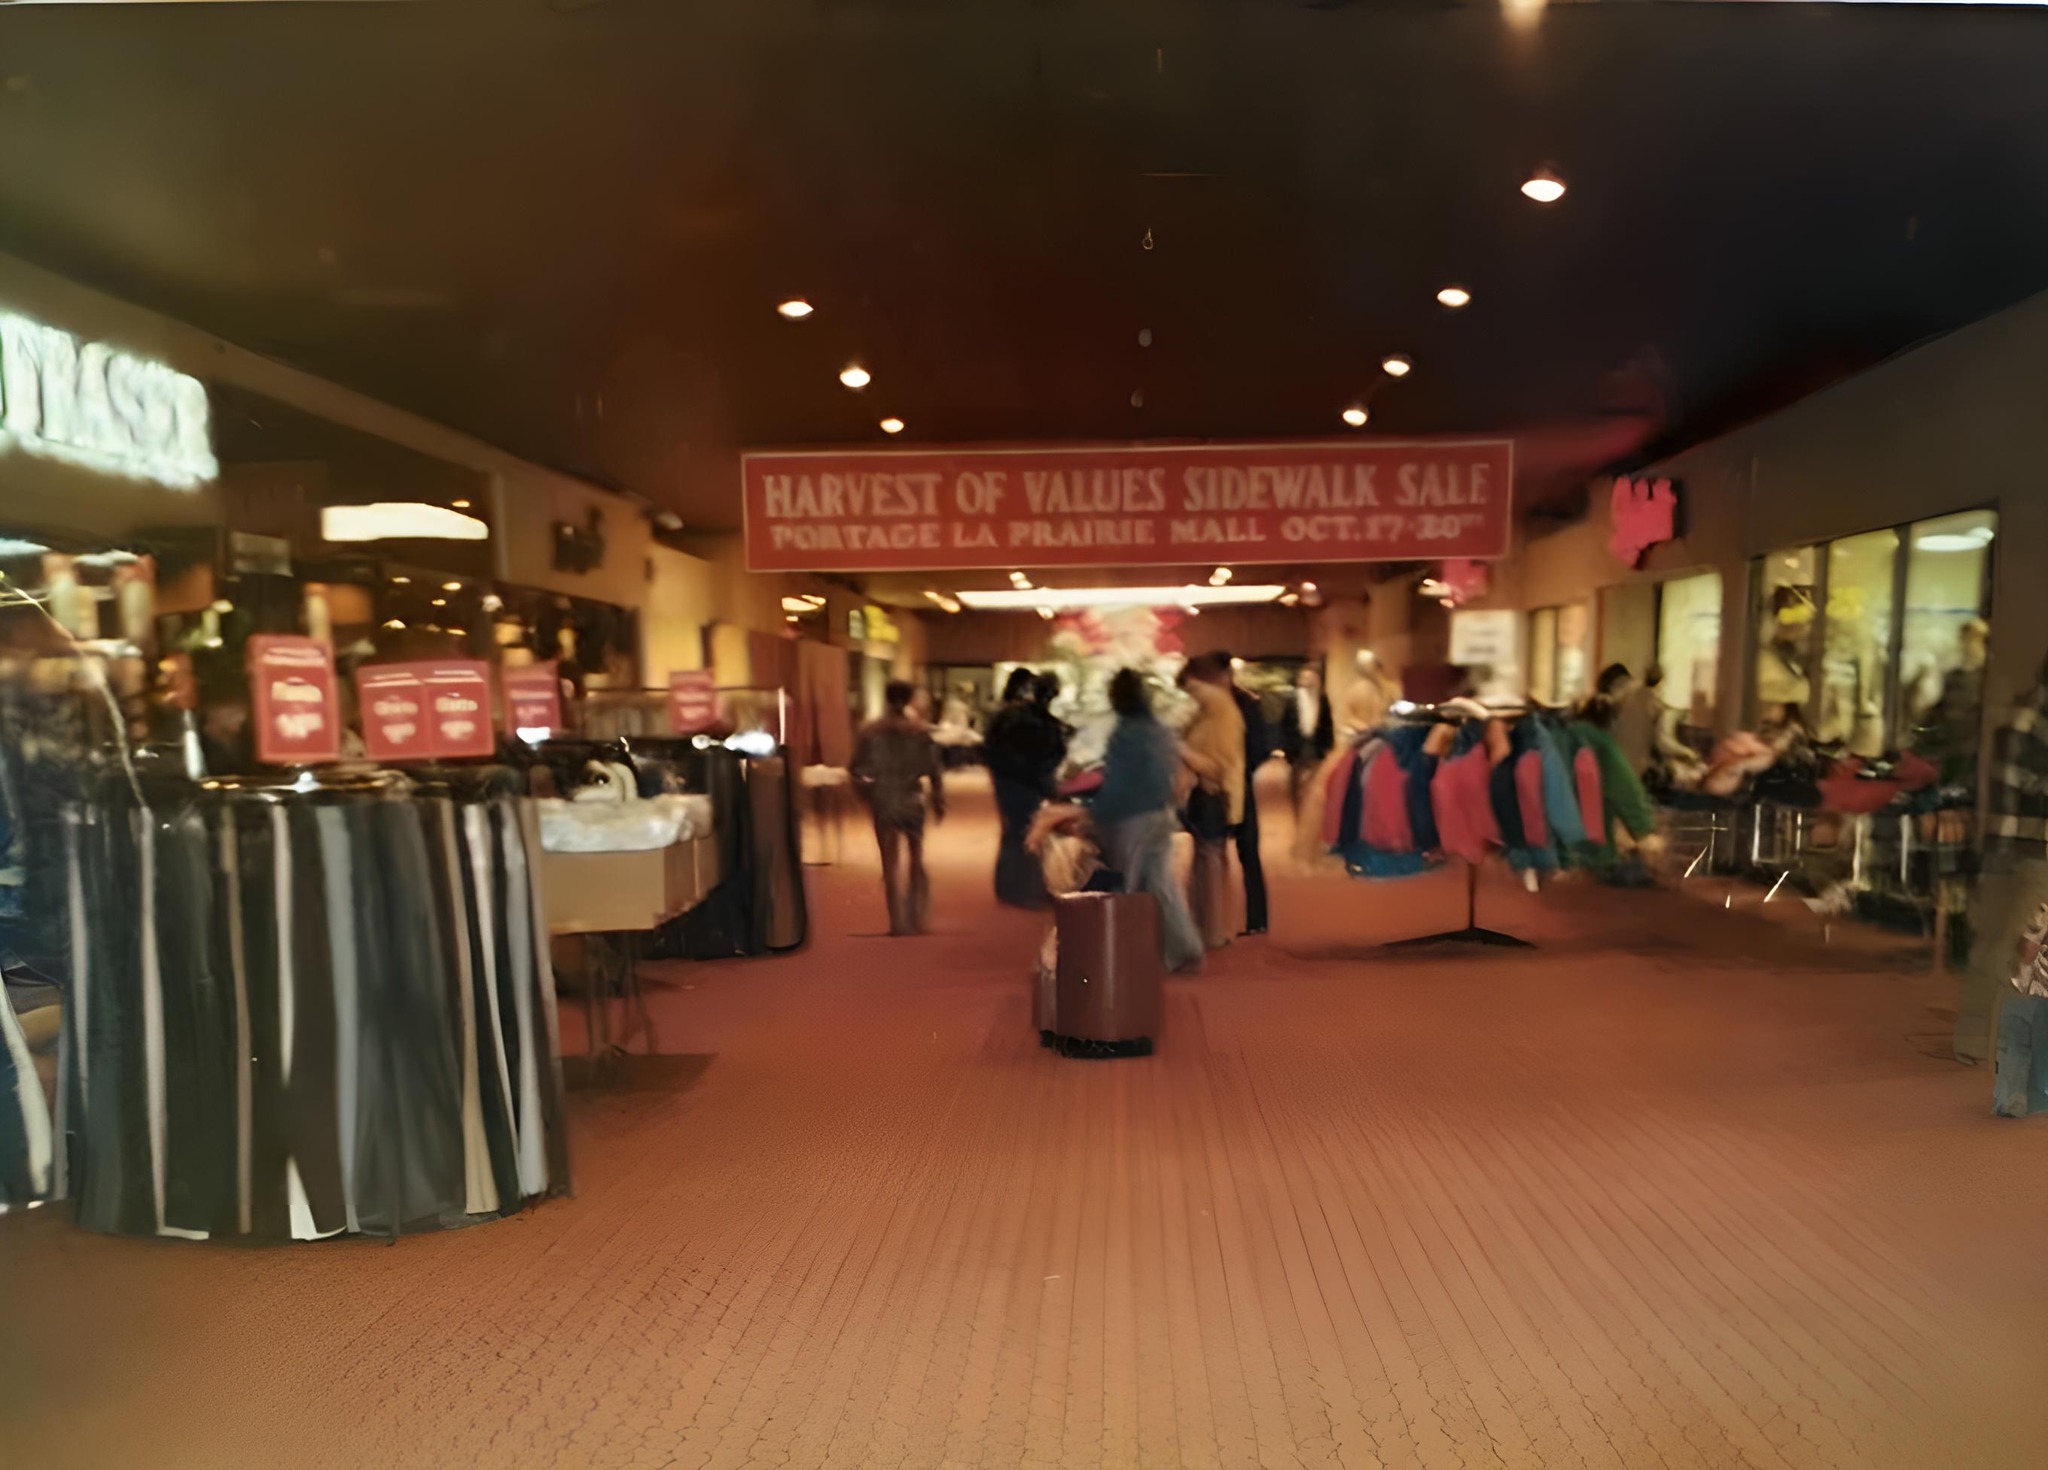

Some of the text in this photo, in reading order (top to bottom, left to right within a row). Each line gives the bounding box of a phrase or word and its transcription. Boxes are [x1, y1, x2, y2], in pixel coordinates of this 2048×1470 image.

[762, 462, 1490, 518] HARVEST OF VALUES SIDEWALK SALE
[769, 522, 941, 550] PORTAGE
[952, 521, 999, 548] LA
[1007, 519, 1156, 547] PRAIRIE
[1169, 517, 1267, 544] MALL
